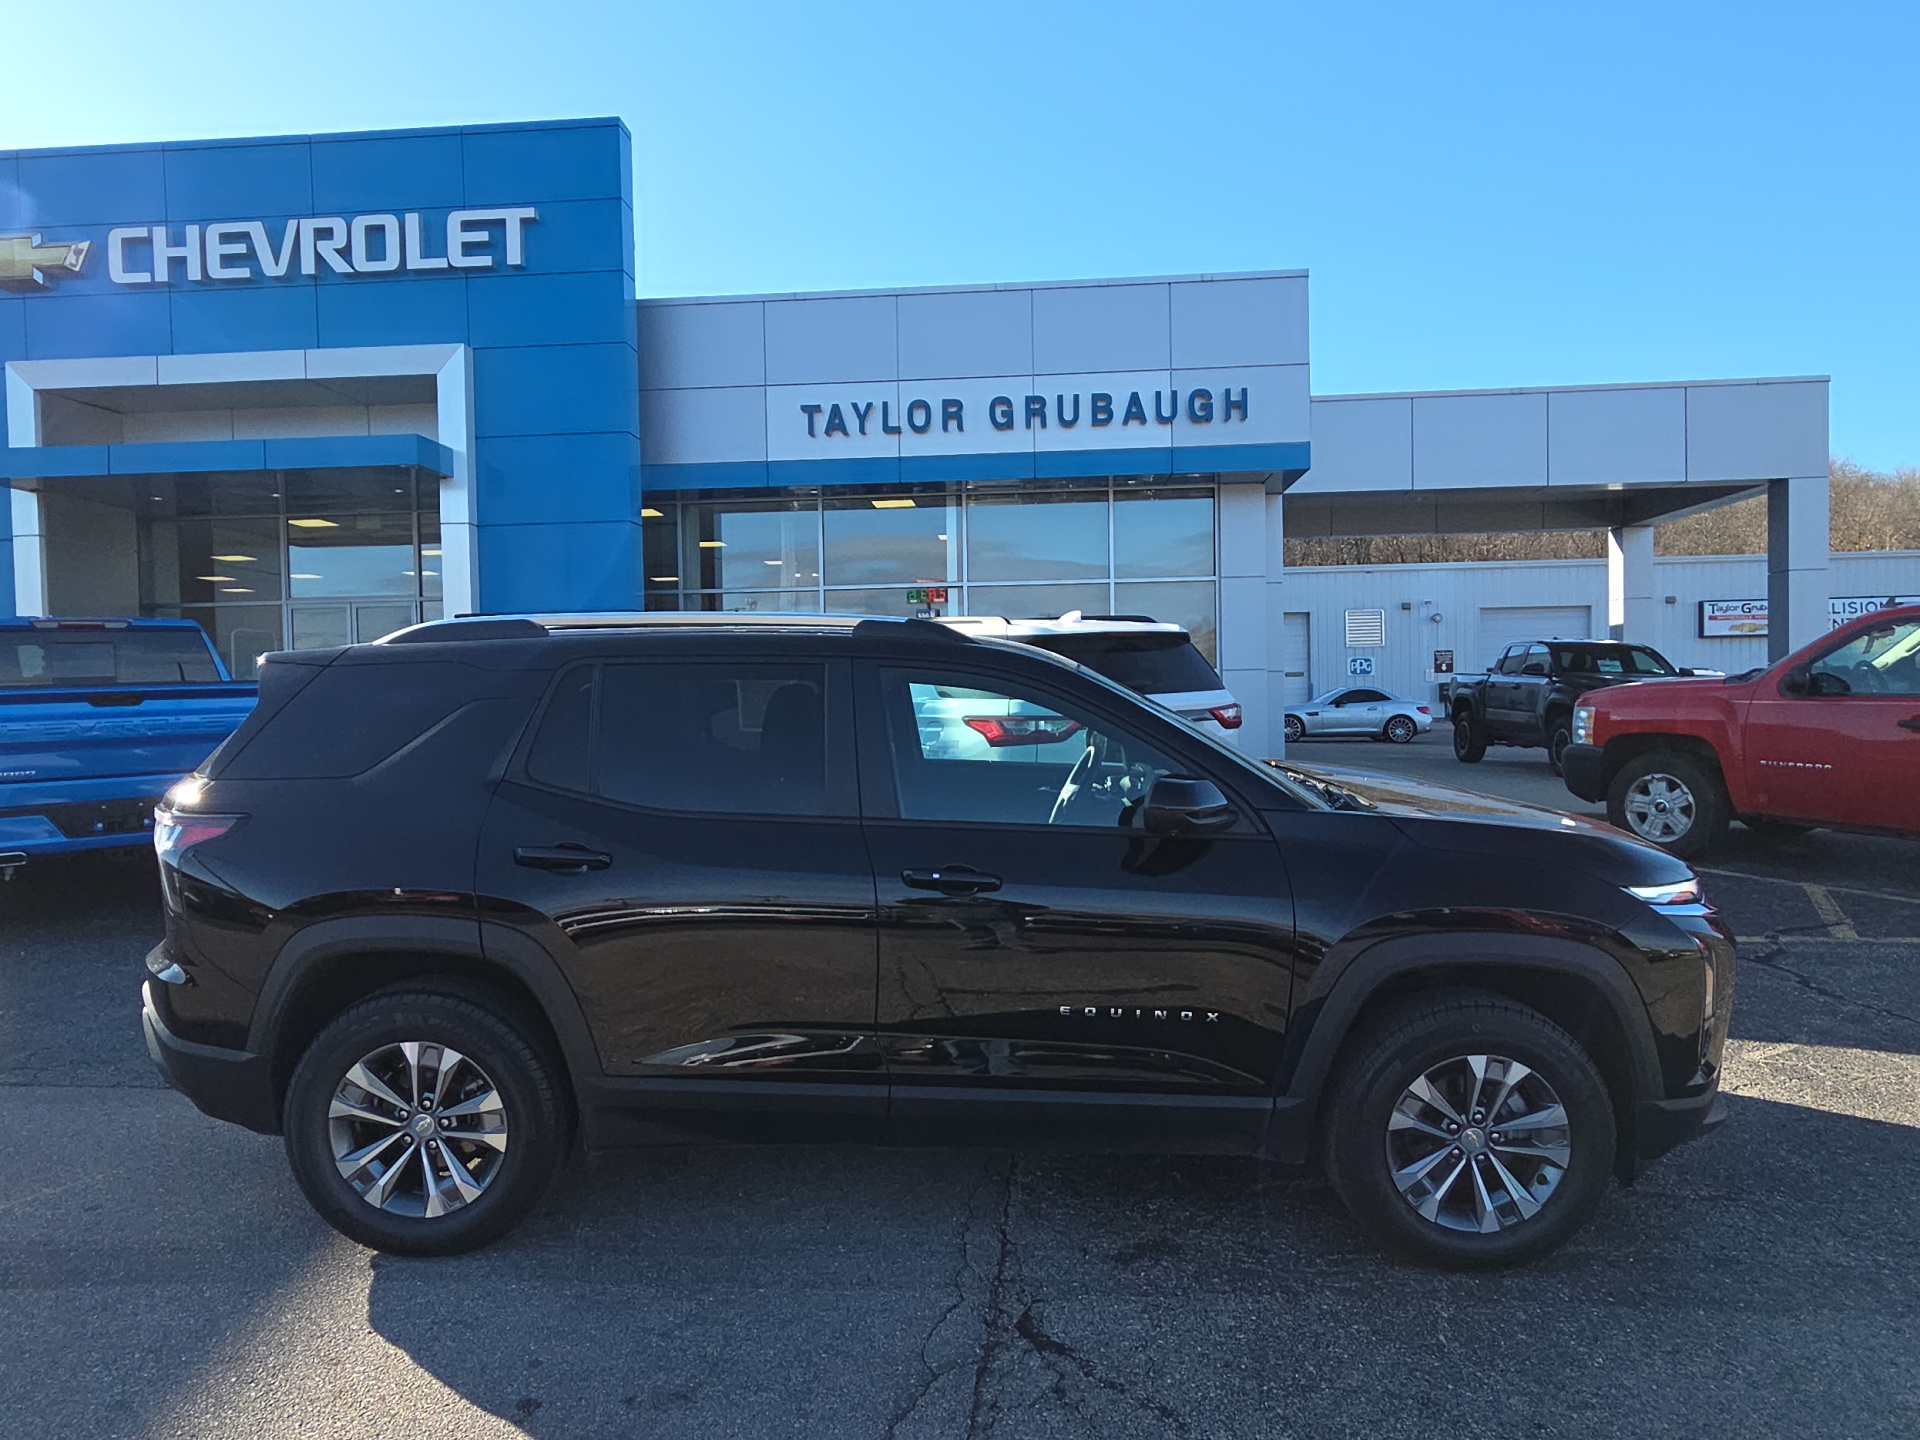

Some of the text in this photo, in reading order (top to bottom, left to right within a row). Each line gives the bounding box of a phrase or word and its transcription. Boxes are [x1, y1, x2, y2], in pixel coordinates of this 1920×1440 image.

[108, 207, 538, 285] CHEVROLET
[800, 387, 1249, 438] TAYLOR GRUBAUGH
[1708, 602, 1768, 614] Taylor Grub
[1828, 601, 1887, 614] LISIO
[1351, 659, 1371, 674] PPG
[1059, 1005, 1219, 1023] EQUINOX
